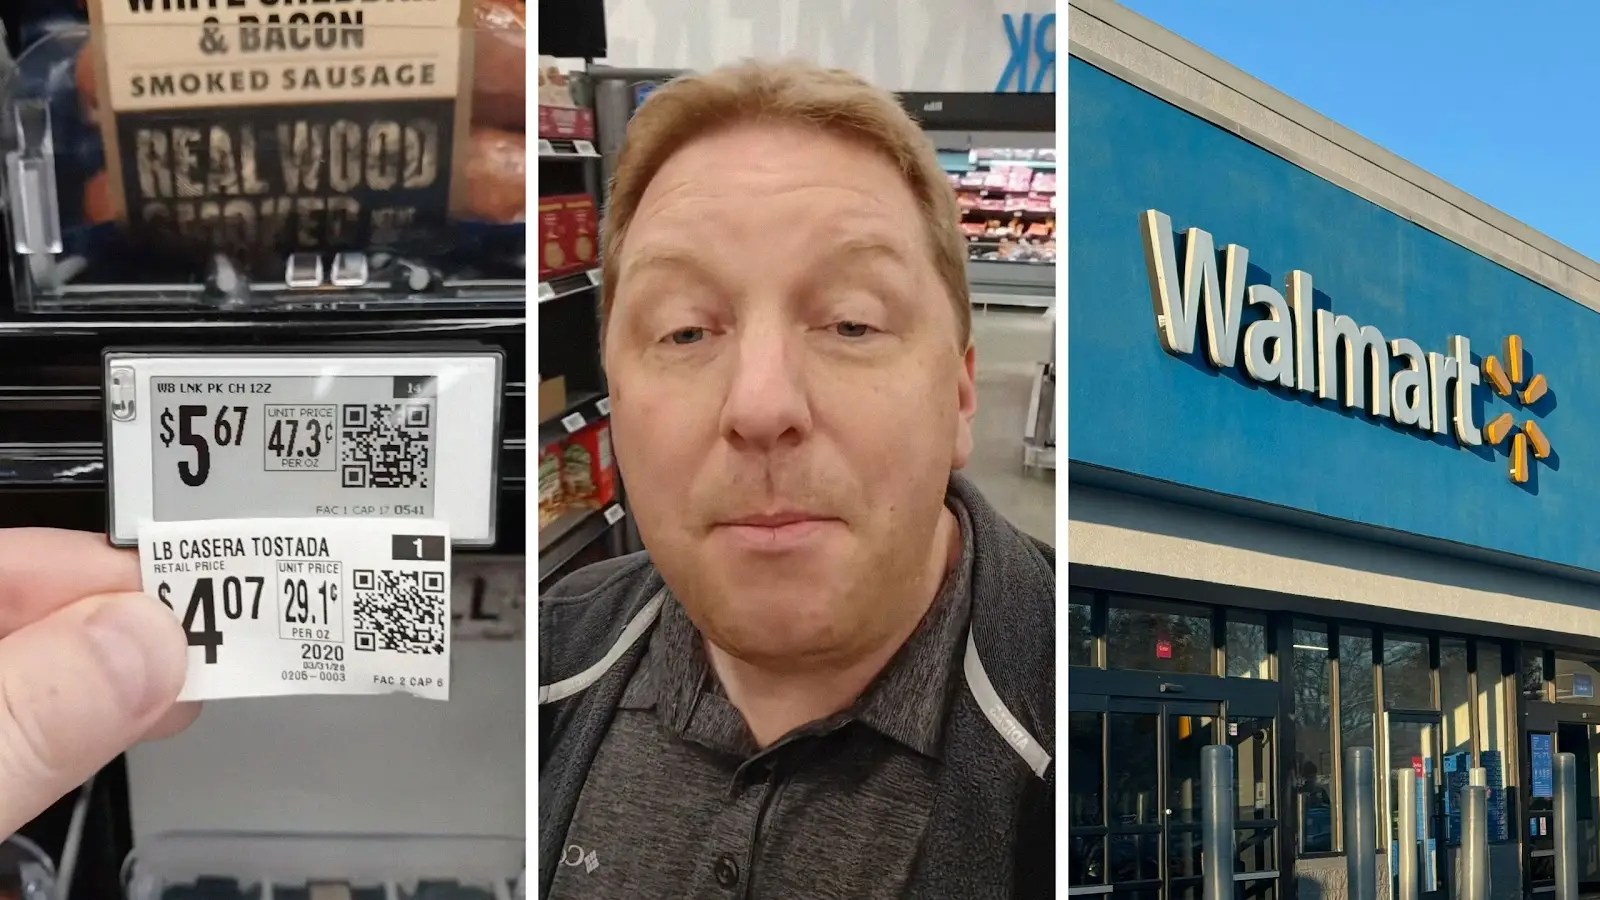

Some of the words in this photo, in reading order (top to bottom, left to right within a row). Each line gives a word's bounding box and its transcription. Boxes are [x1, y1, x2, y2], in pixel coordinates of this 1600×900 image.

[200, 17, 228, 53] &
[239, 11, 364, 51] BACON
[131, 72, 269, 97] SMOKED
[282, 64, 436, 90] SAUSAGE
[136, 126, 270, 198] REAL
[276, 119, 438, 193] WOOD
[1139, 209, 1482, 446] Walmart
[180, 383, 202, 393] LNK
[208, 383, 223, 393] PK
[228, 383, 245, 393] CH
[250, 383, 271, 393] 12Z
[268, 408, 295, 417] UNIT
[301, 408, 333, 417] PRICE
[282, 459, 302, 468] PER
[304, 459, 319, 468] OZ
[316, 506, 338, 514] FAC
[343, 506, 348, 514] 1
[352, 506, 375, 514] CAP
[379, 506, 390, 514] 17
[394, 505, 424, 515] 0541
[153, 541, 173, 560] LB
[180, 538, 245, 560] CASERA
[252, 536, 330, 557] TOSTADA
[412, 538, 423, 558] 1
[154, 563, 191, 573] RETAIL
[195, 560, 225, 571] PRICE
[279, 562, 303, 573] UNIT
[308, 563, 339, 574] PRICE
[292, 627, 312, 639] PER
[316, 629, 330, 640] OZ
[301, 643, 344, 661] 2020
[373, 674, 395, 685] FAC
[400, 676, 406, 686] 2
[410, 676, 432, 687] CAP
